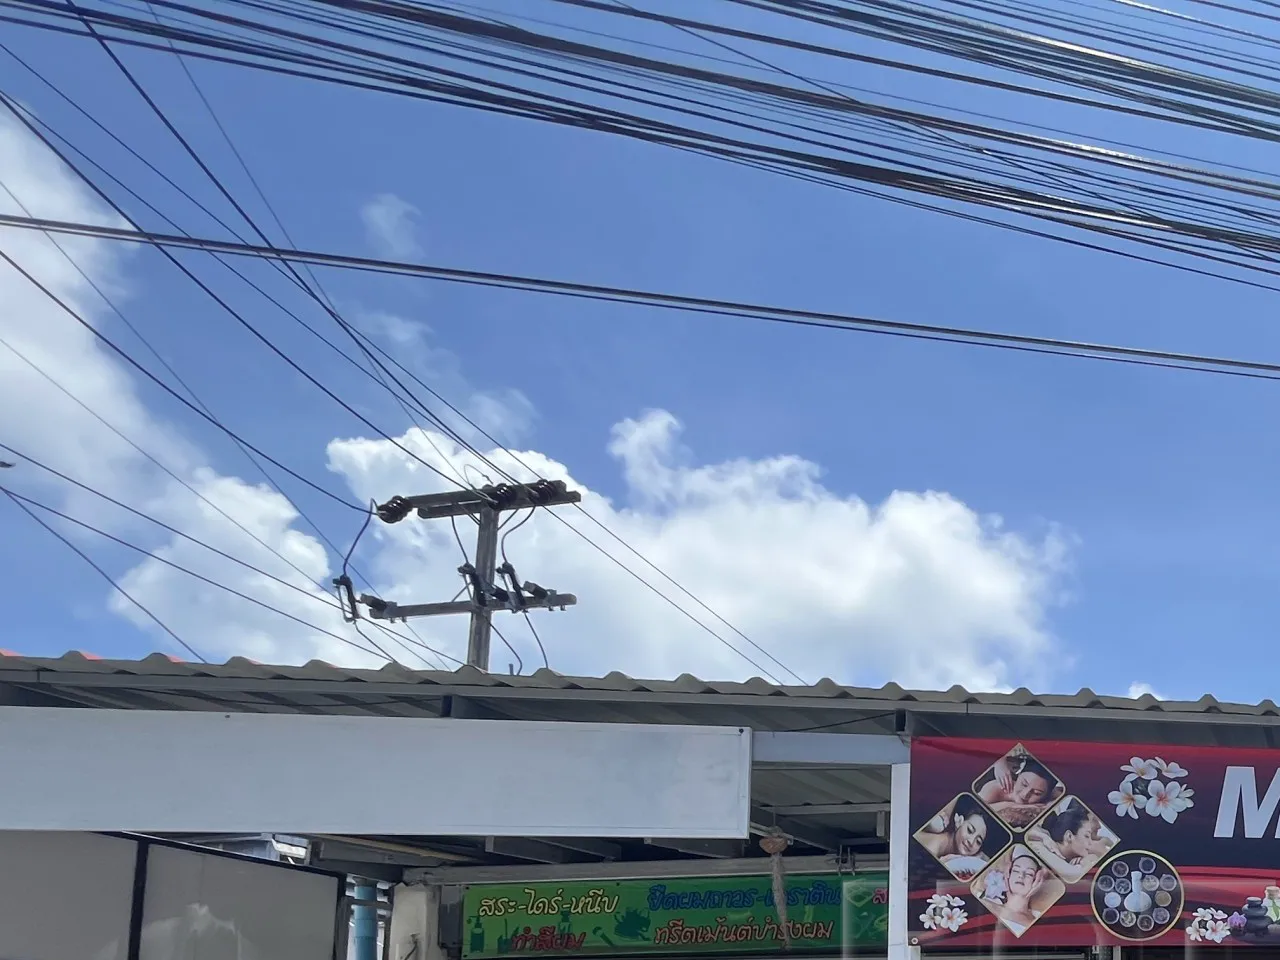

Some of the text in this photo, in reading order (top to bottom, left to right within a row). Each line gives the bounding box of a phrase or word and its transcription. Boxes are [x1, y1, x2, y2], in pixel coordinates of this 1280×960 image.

[479, 888, 619, 916] สระ-ไดร์-หนีบ
